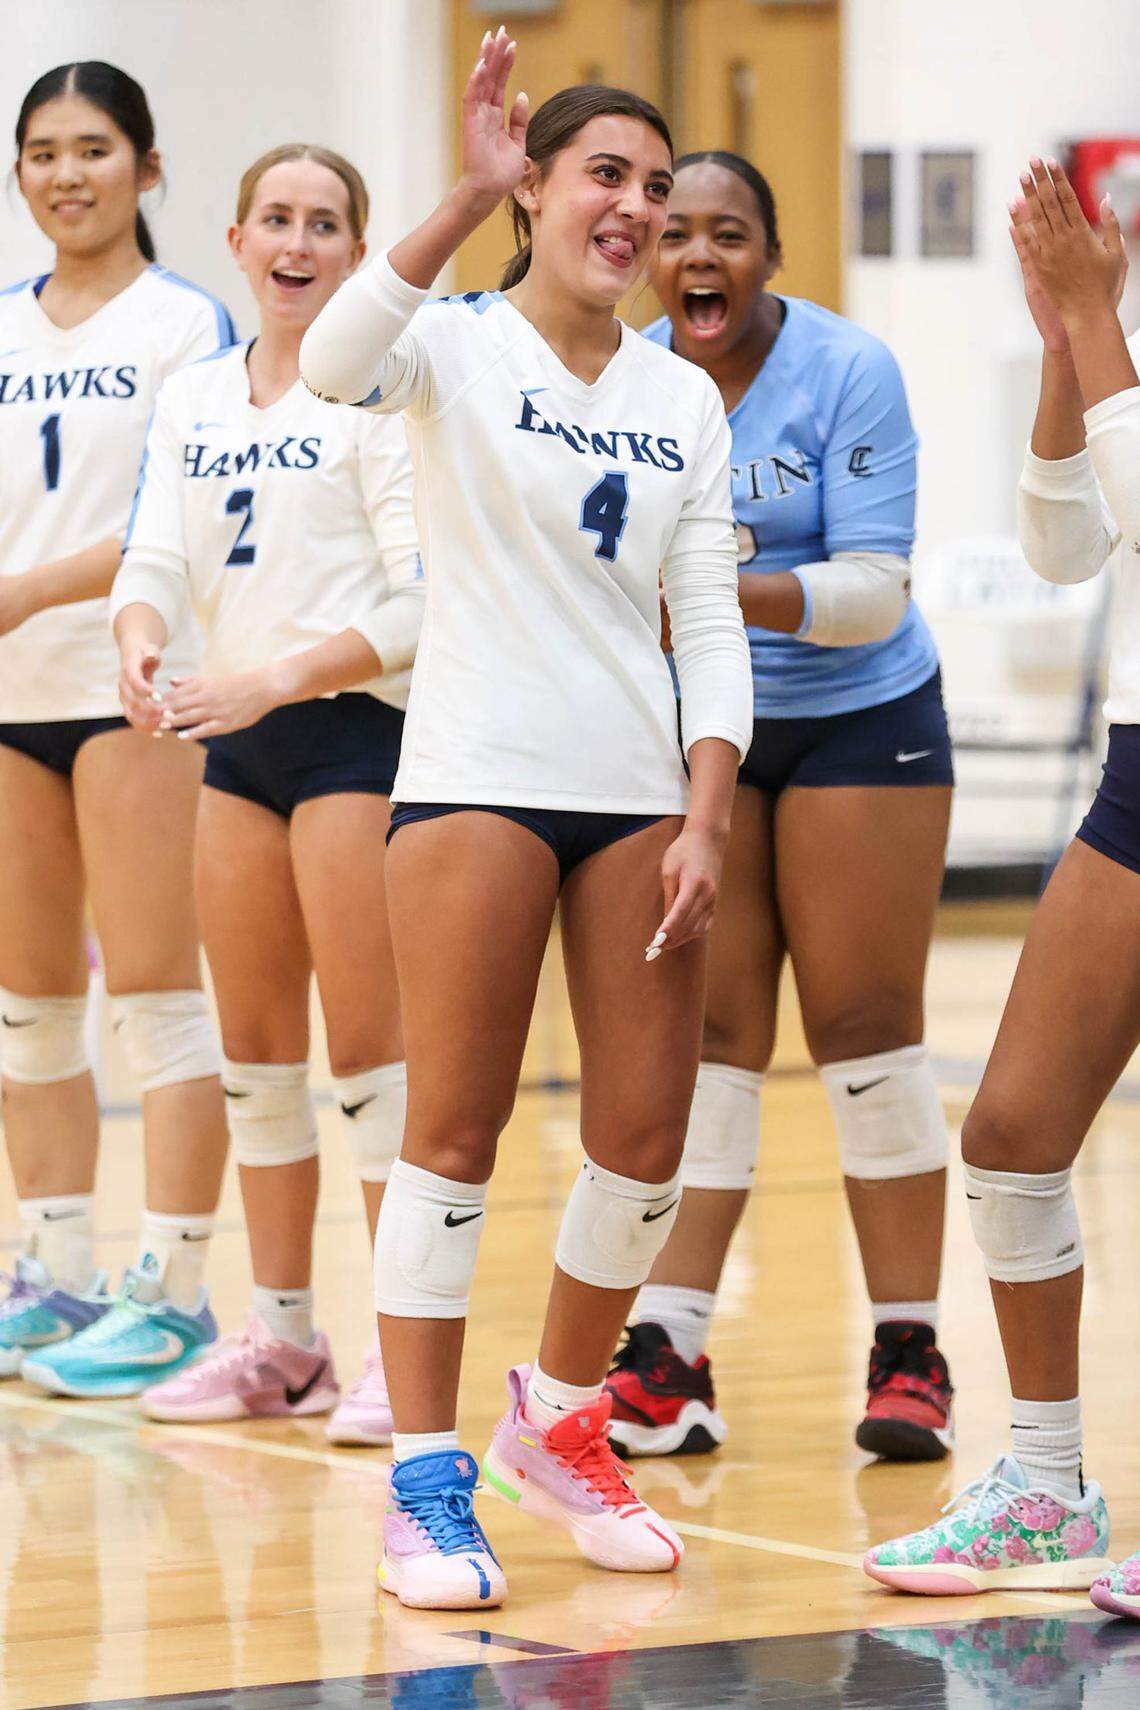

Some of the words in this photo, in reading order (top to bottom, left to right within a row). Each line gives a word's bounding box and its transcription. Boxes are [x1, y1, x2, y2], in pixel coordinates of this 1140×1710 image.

[40, 411, 62, 492] 1
[184, 436, 322, 477] HAWKS
[224, 486, 256, 567] 2
[578, 469, 630, 563] 4
